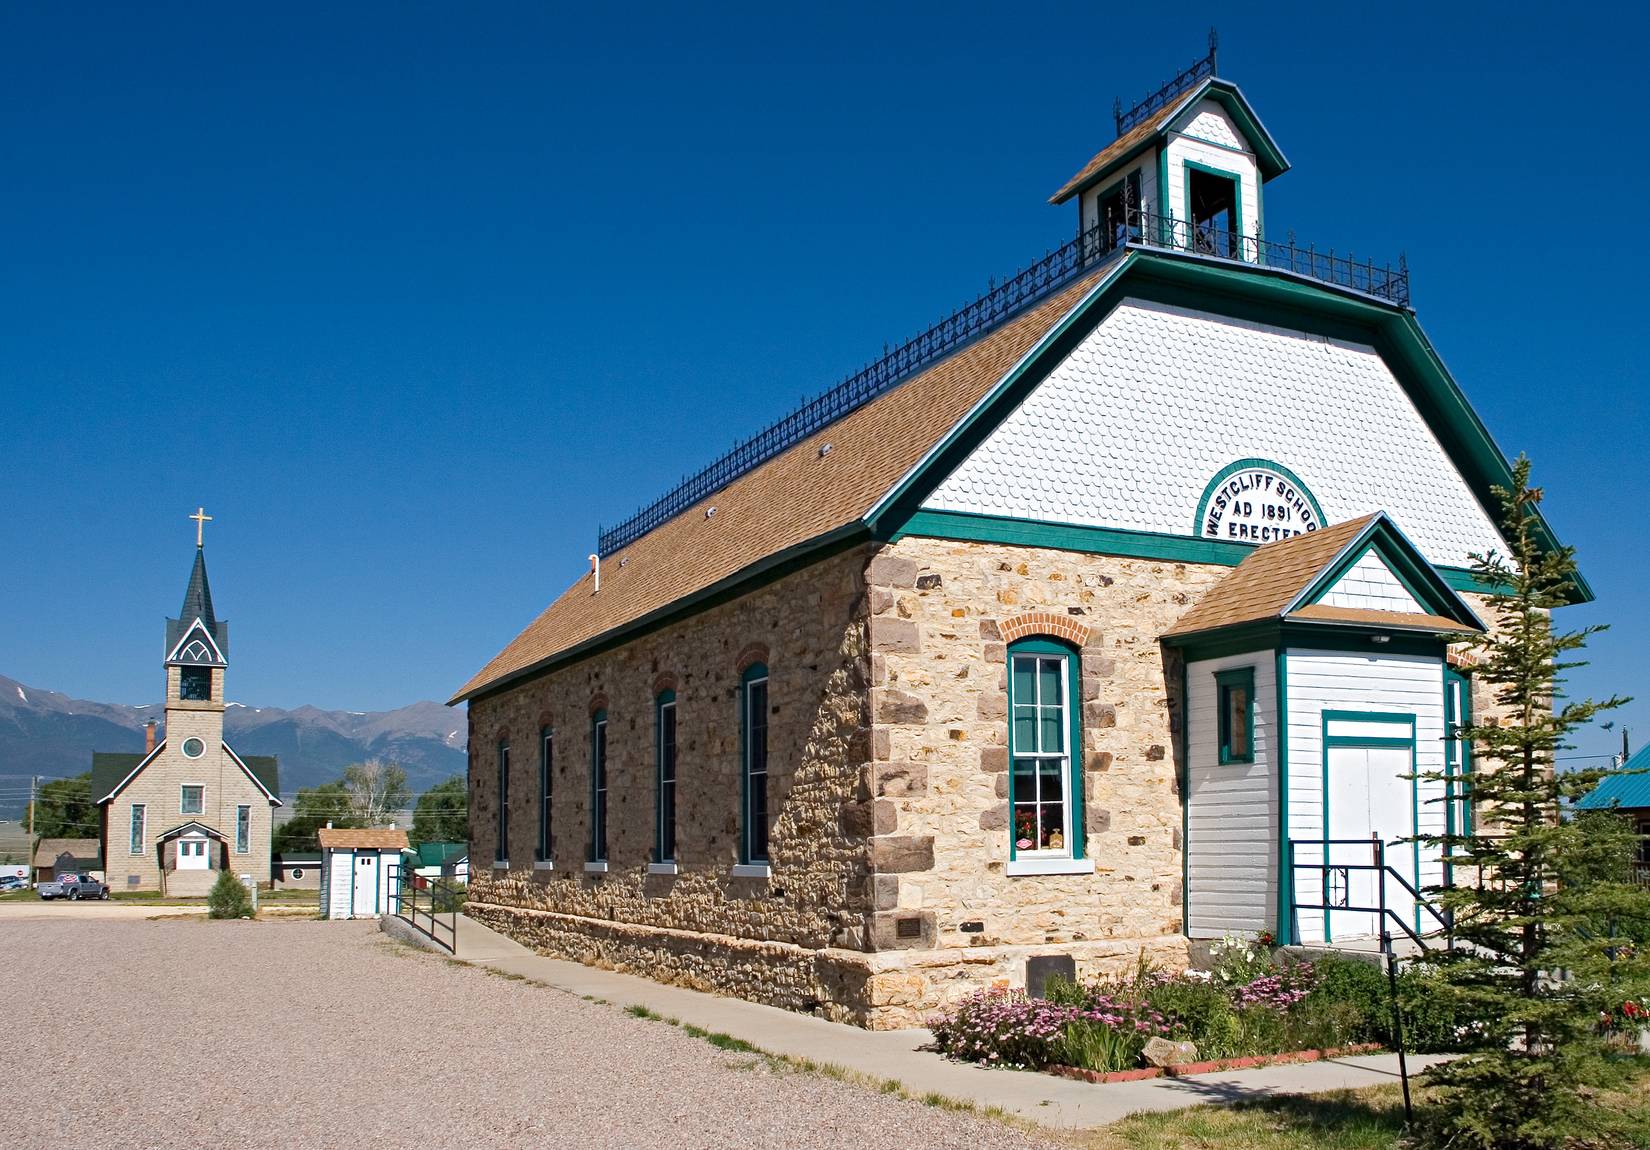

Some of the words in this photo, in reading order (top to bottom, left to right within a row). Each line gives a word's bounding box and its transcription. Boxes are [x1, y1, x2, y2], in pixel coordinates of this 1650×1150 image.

[1206, 474, 1274, 536] WESTCLIFF
[1276, 481, 1316, 532] SCHOO
[1233, 501, 1252, 517] AD
[1262, 503, 1291, 521] 1891
